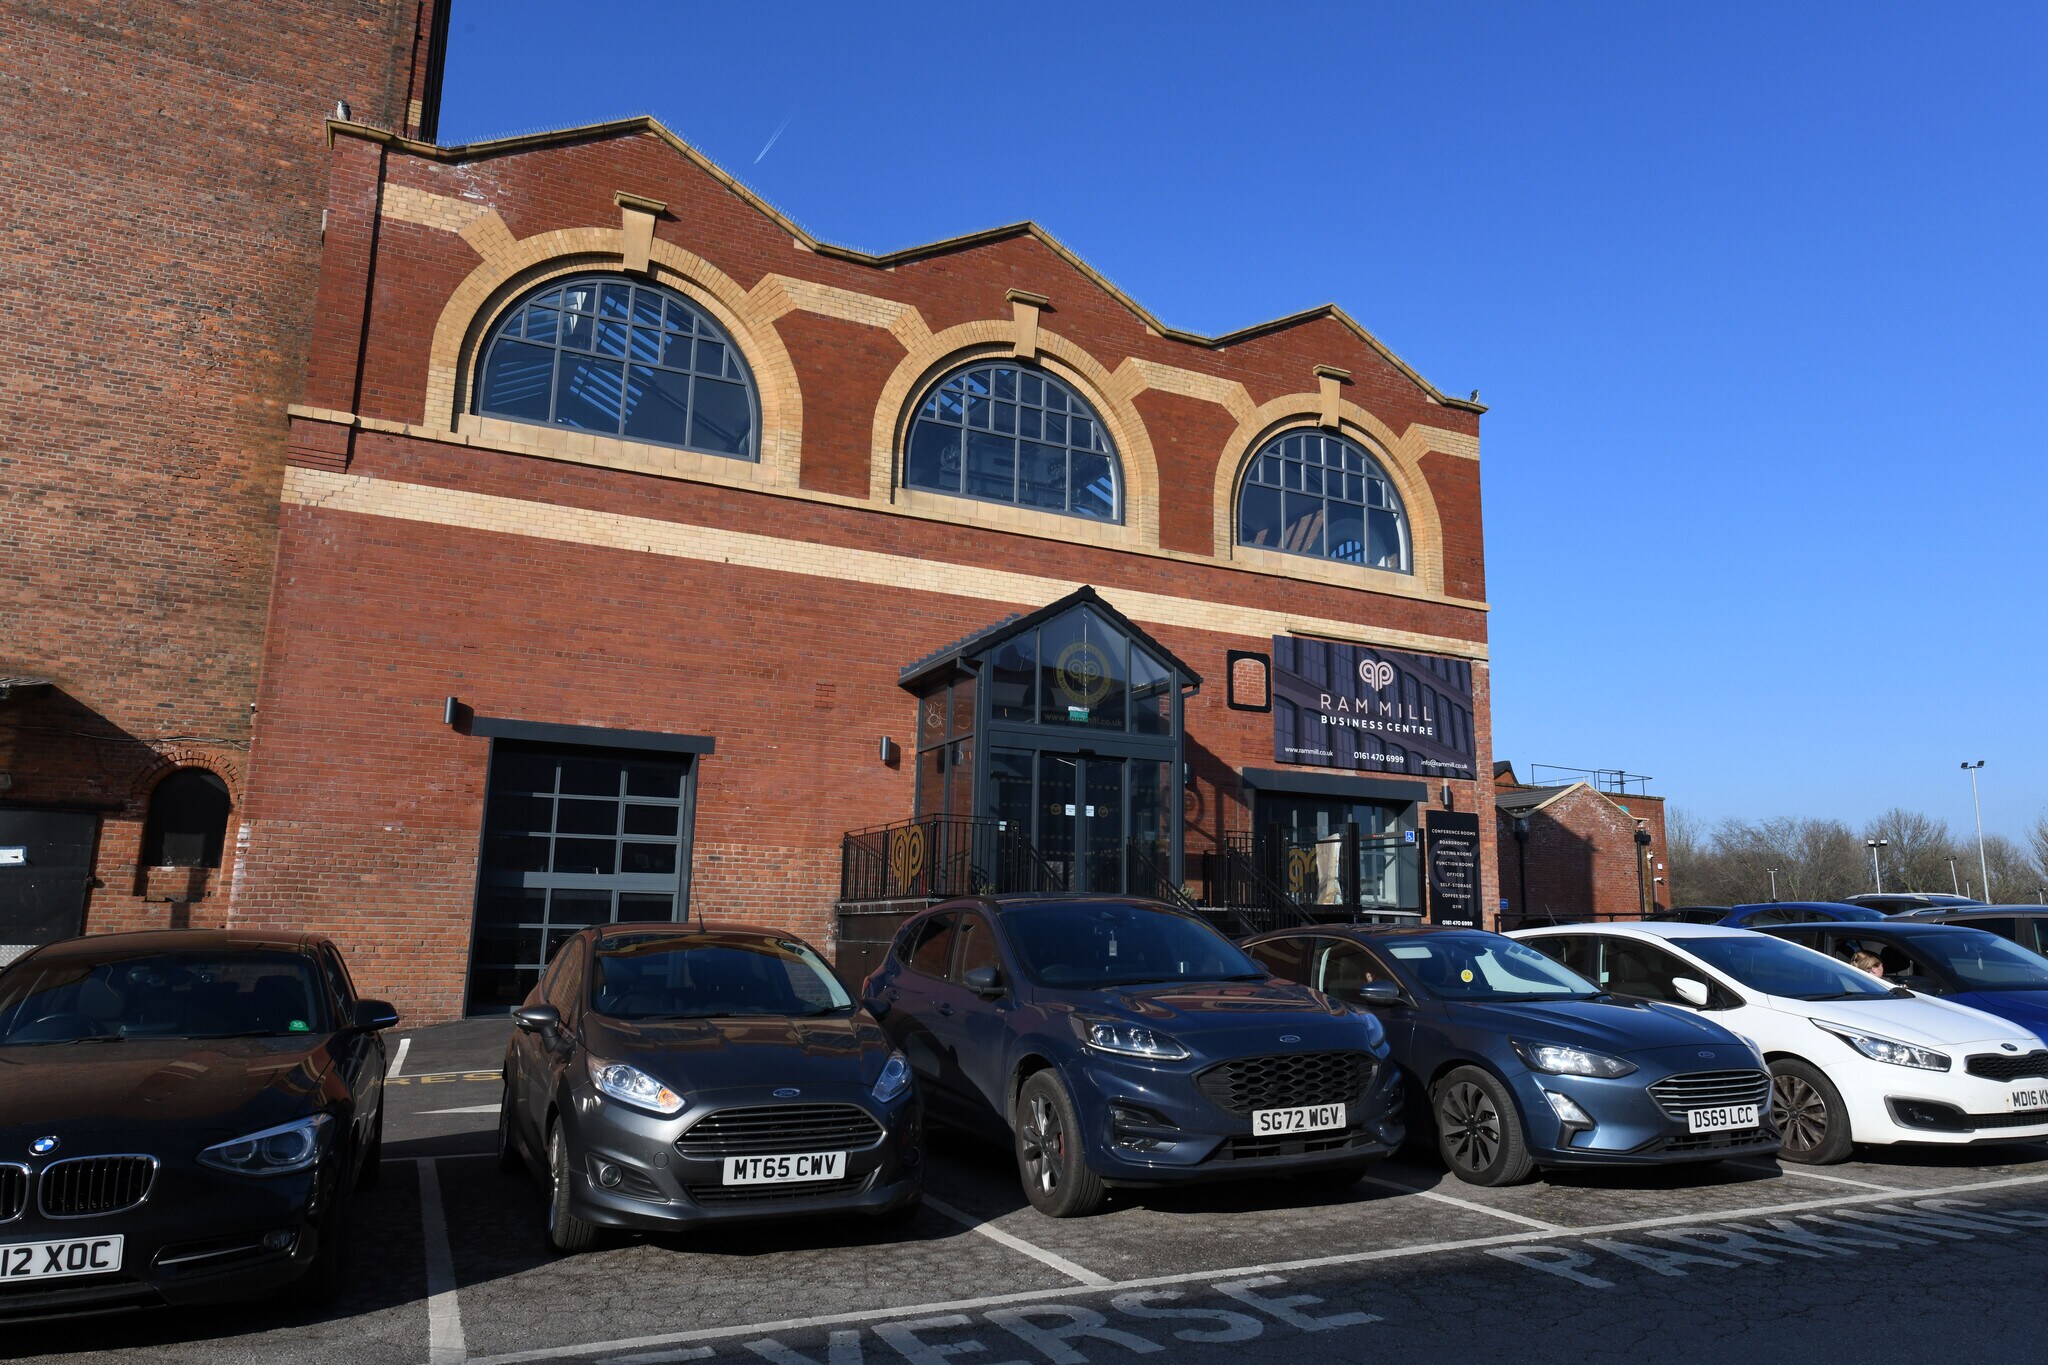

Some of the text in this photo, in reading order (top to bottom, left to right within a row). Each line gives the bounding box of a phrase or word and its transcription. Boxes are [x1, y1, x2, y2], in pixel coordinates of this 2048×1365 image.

[1320, 693, 1433, 722] RAM MILL
[1321, 715, 1433, 736] BUSINESS CENTRE
[1285, 746, 1334, 757] www.rammill.co.uk
[1353, 751, 1404, 764] 0161 470 6999
[1421, 759, 1468, 770] info@rammill.co.uk
[2012, 1090, 2039, 1107] MD16
[1260, 1106, 1339, 1131] SG72 WGV
[1694, 1106, 1753, 1128] DS69 LCC
[733, 1154, 837, 1180] MT65 CWV
[1483, 1198, 2048, 1288] PARKING
[43, 1240, 111, 1273] XOC
[593, 1275, 1384, 1365] VERSE
